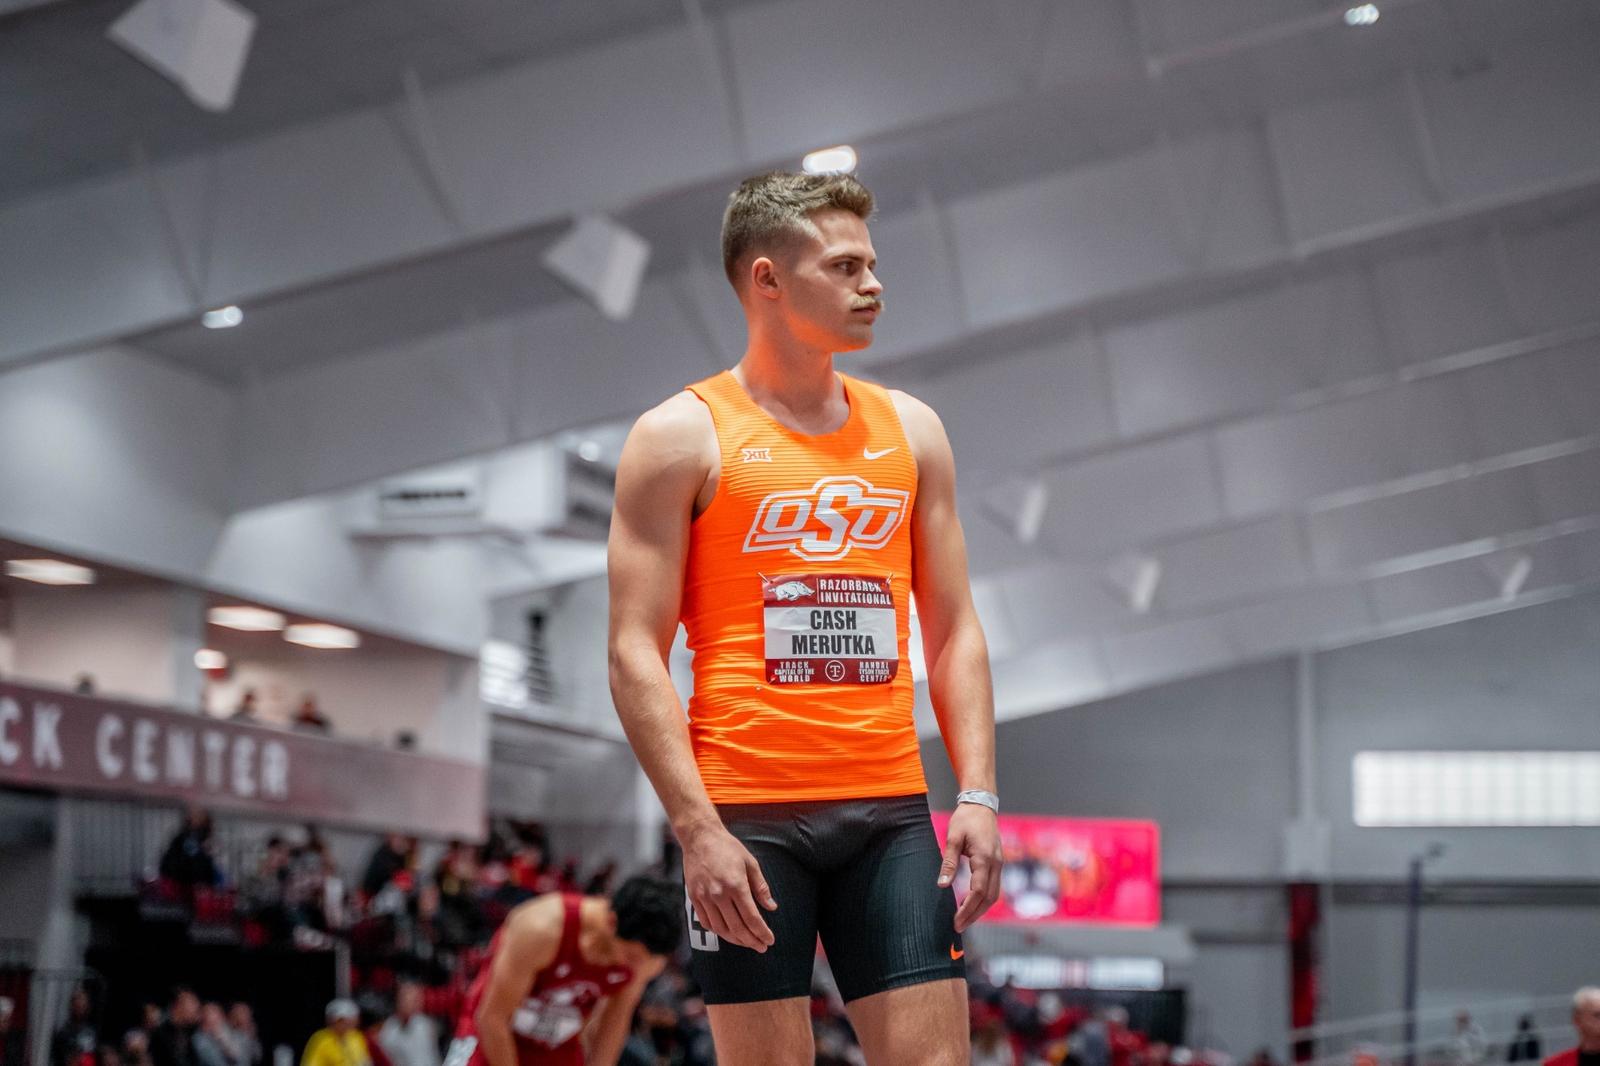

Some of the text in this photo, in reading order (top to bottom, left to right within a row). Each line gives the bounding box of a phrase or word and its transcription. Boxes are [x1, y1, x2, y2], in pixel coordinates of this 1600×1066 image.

[743, 476, 910, 561] OSU
[820, 579, 882, 592] RAZORBACK
[820, 592, 891, 605] INVITATIONAL
[810, 610, 857, 630] CASH
[792, 635, 875, 655] MERUTKA
[780, 661, 809, 669] TRACK
[779, 674, 810, 682] WORLD
[96, 713, 288, 799] CENTER
